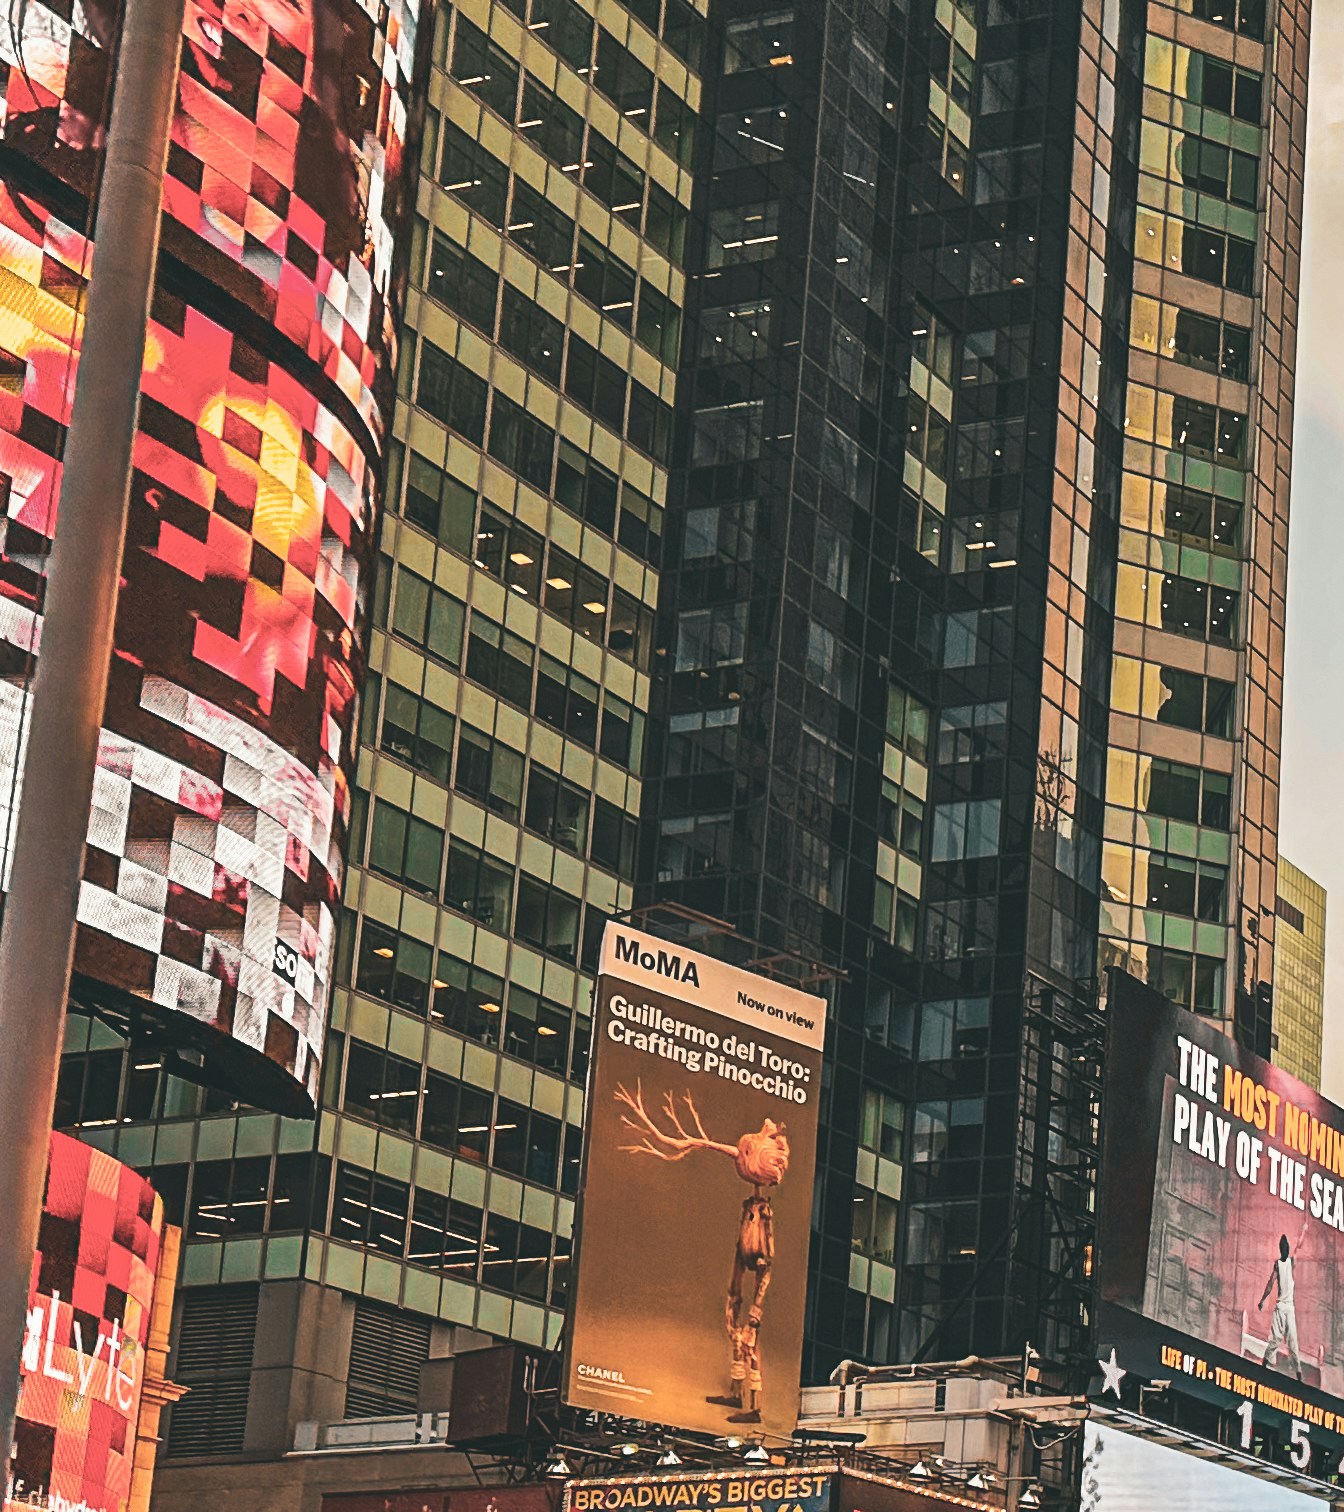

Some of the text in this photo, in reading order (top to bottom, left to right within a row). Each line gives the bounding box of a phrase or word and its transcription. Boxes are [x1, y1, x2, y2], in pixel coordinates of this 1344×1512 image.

[615, 936, 700, 987] MoMA
[609, 995, 811, 1082] Guillermo del Toro:
[737, 991, 815, 1030] Now on view
[607, 1019, 808, 1104] Crafting Pinocchio
[1177, 1036, 1219, 1103] THE
[1223, 1063, 1279, 1138] MOST
[1173, 1093, 1231, 1168] PLAY
[1236, 1132, 1264, 1185] OF
[1267, 1146, 1306, 1211] THE
[577, 1364, 627, 1383] CHANEL
[1161, 1345, 1183, 1370] LIFE
[1183, 1354, 1196, 1375] OF
[1196, 1359, 1207, 1380] PI
[1215, 1366, 1232, 1390] THE
[1233, 1374, 1257, 1400] MOST
[1257, 1383, 1304, 1418] NOMINATED
[1304, 1402, 1324, 1427] PLAY
[1324, 1410, 1335, 1430] OF
[575, 1476, 828, 1511] BROADWAY'S BIGGEST
